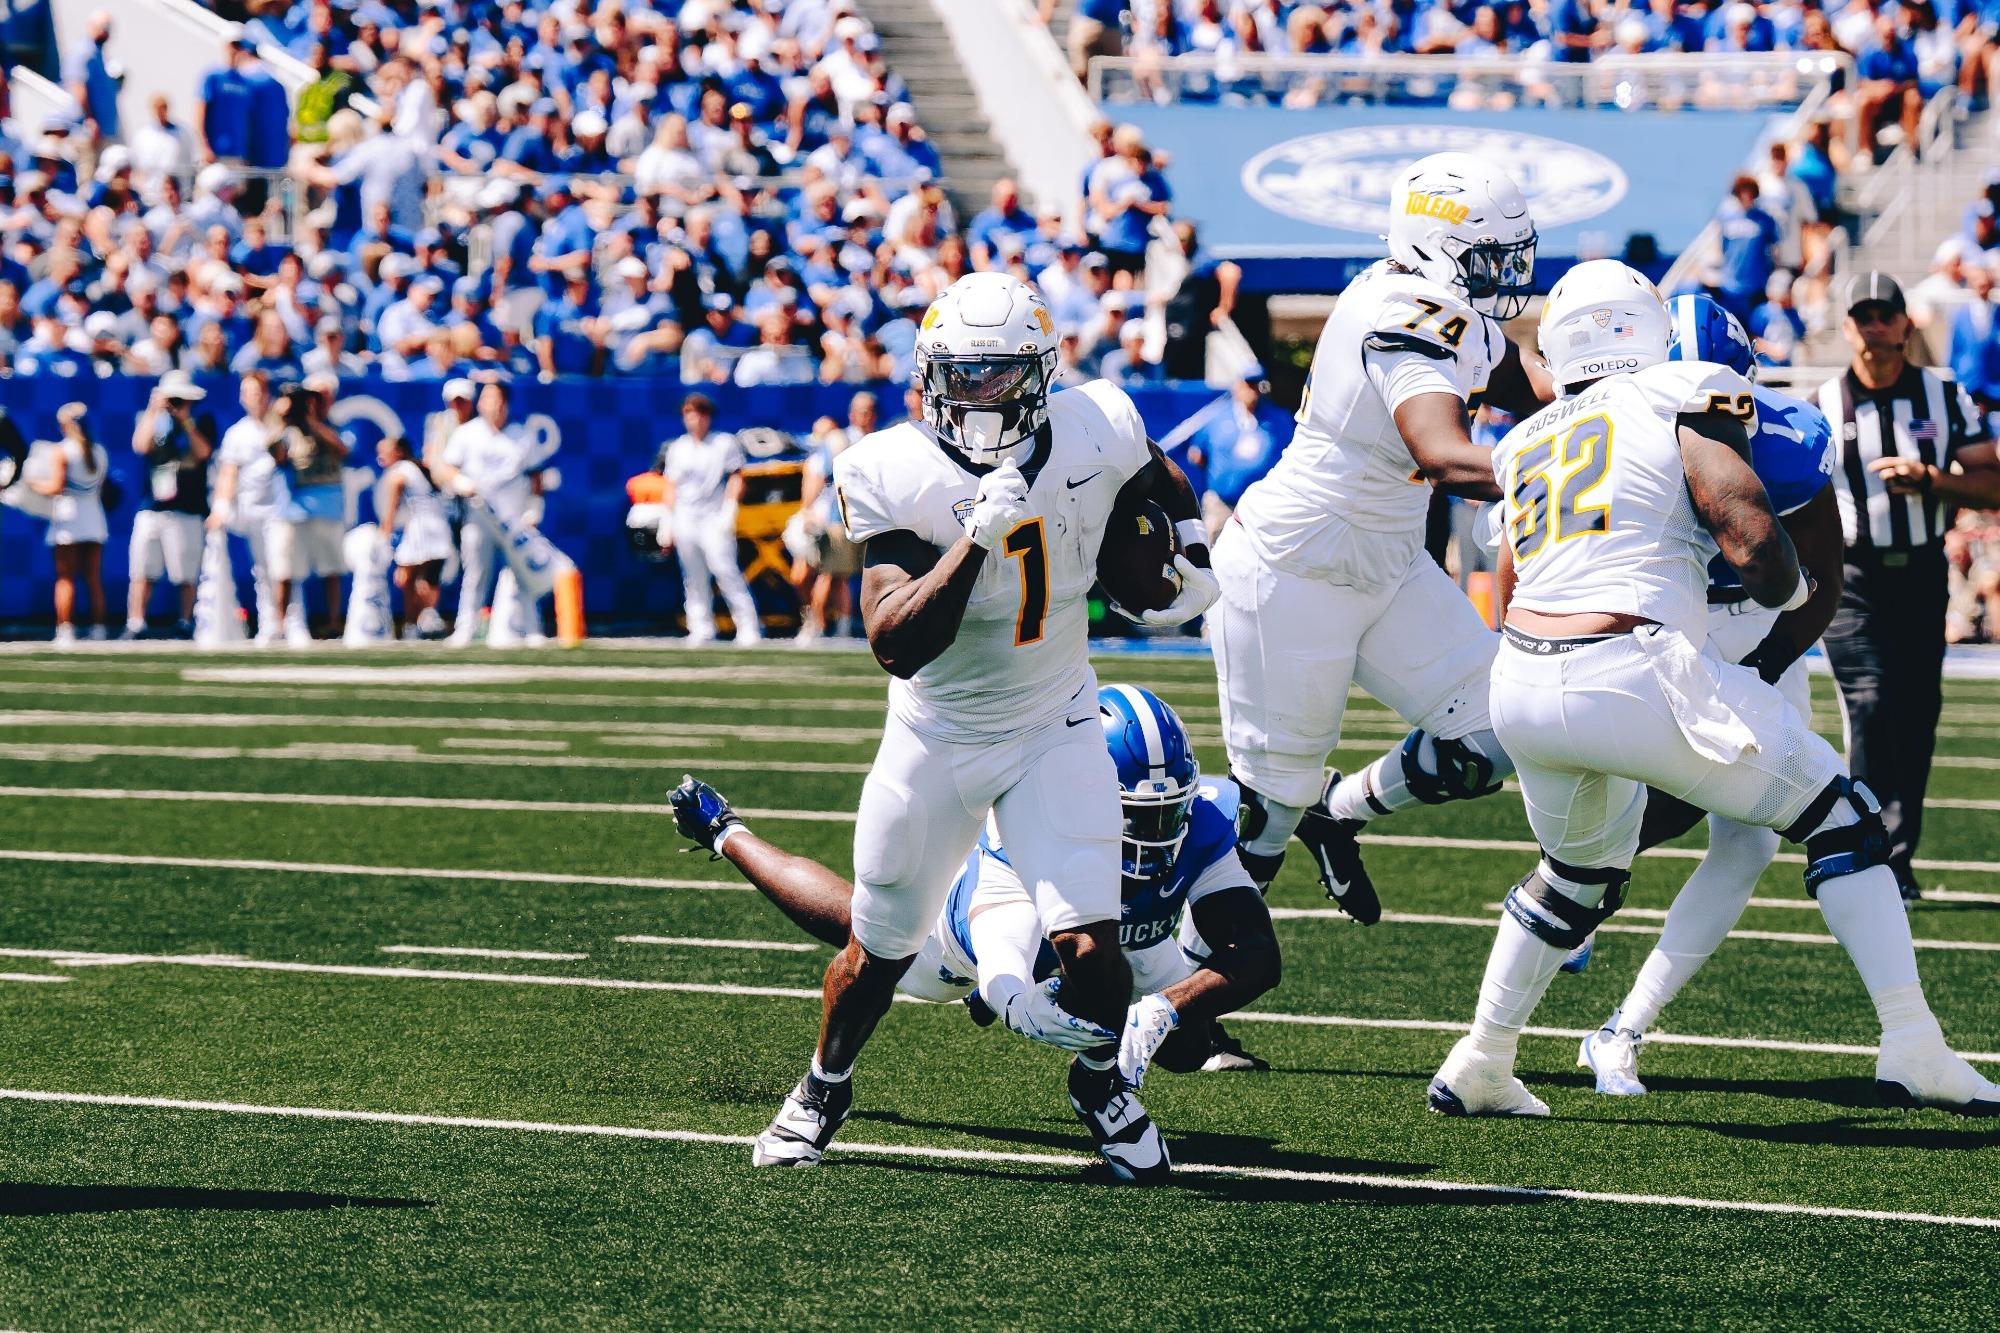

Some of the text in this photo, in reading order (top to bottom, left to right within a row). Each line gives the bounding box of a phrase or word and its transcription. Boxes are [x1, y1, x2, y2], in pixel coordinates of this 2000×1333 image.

[1405, 191, 1470, 225] TOLEDO
[970, 339, 999, 348] GLASS CITY
[1404, 297, 1469, 348] 74
[1580, 358, 1638, 375] TOLEDO
[1525, 388, 1611, 438] BOSWELL
[1511, 413, 1614, 562] 52
[1002, 515, 1050, 647] 1
